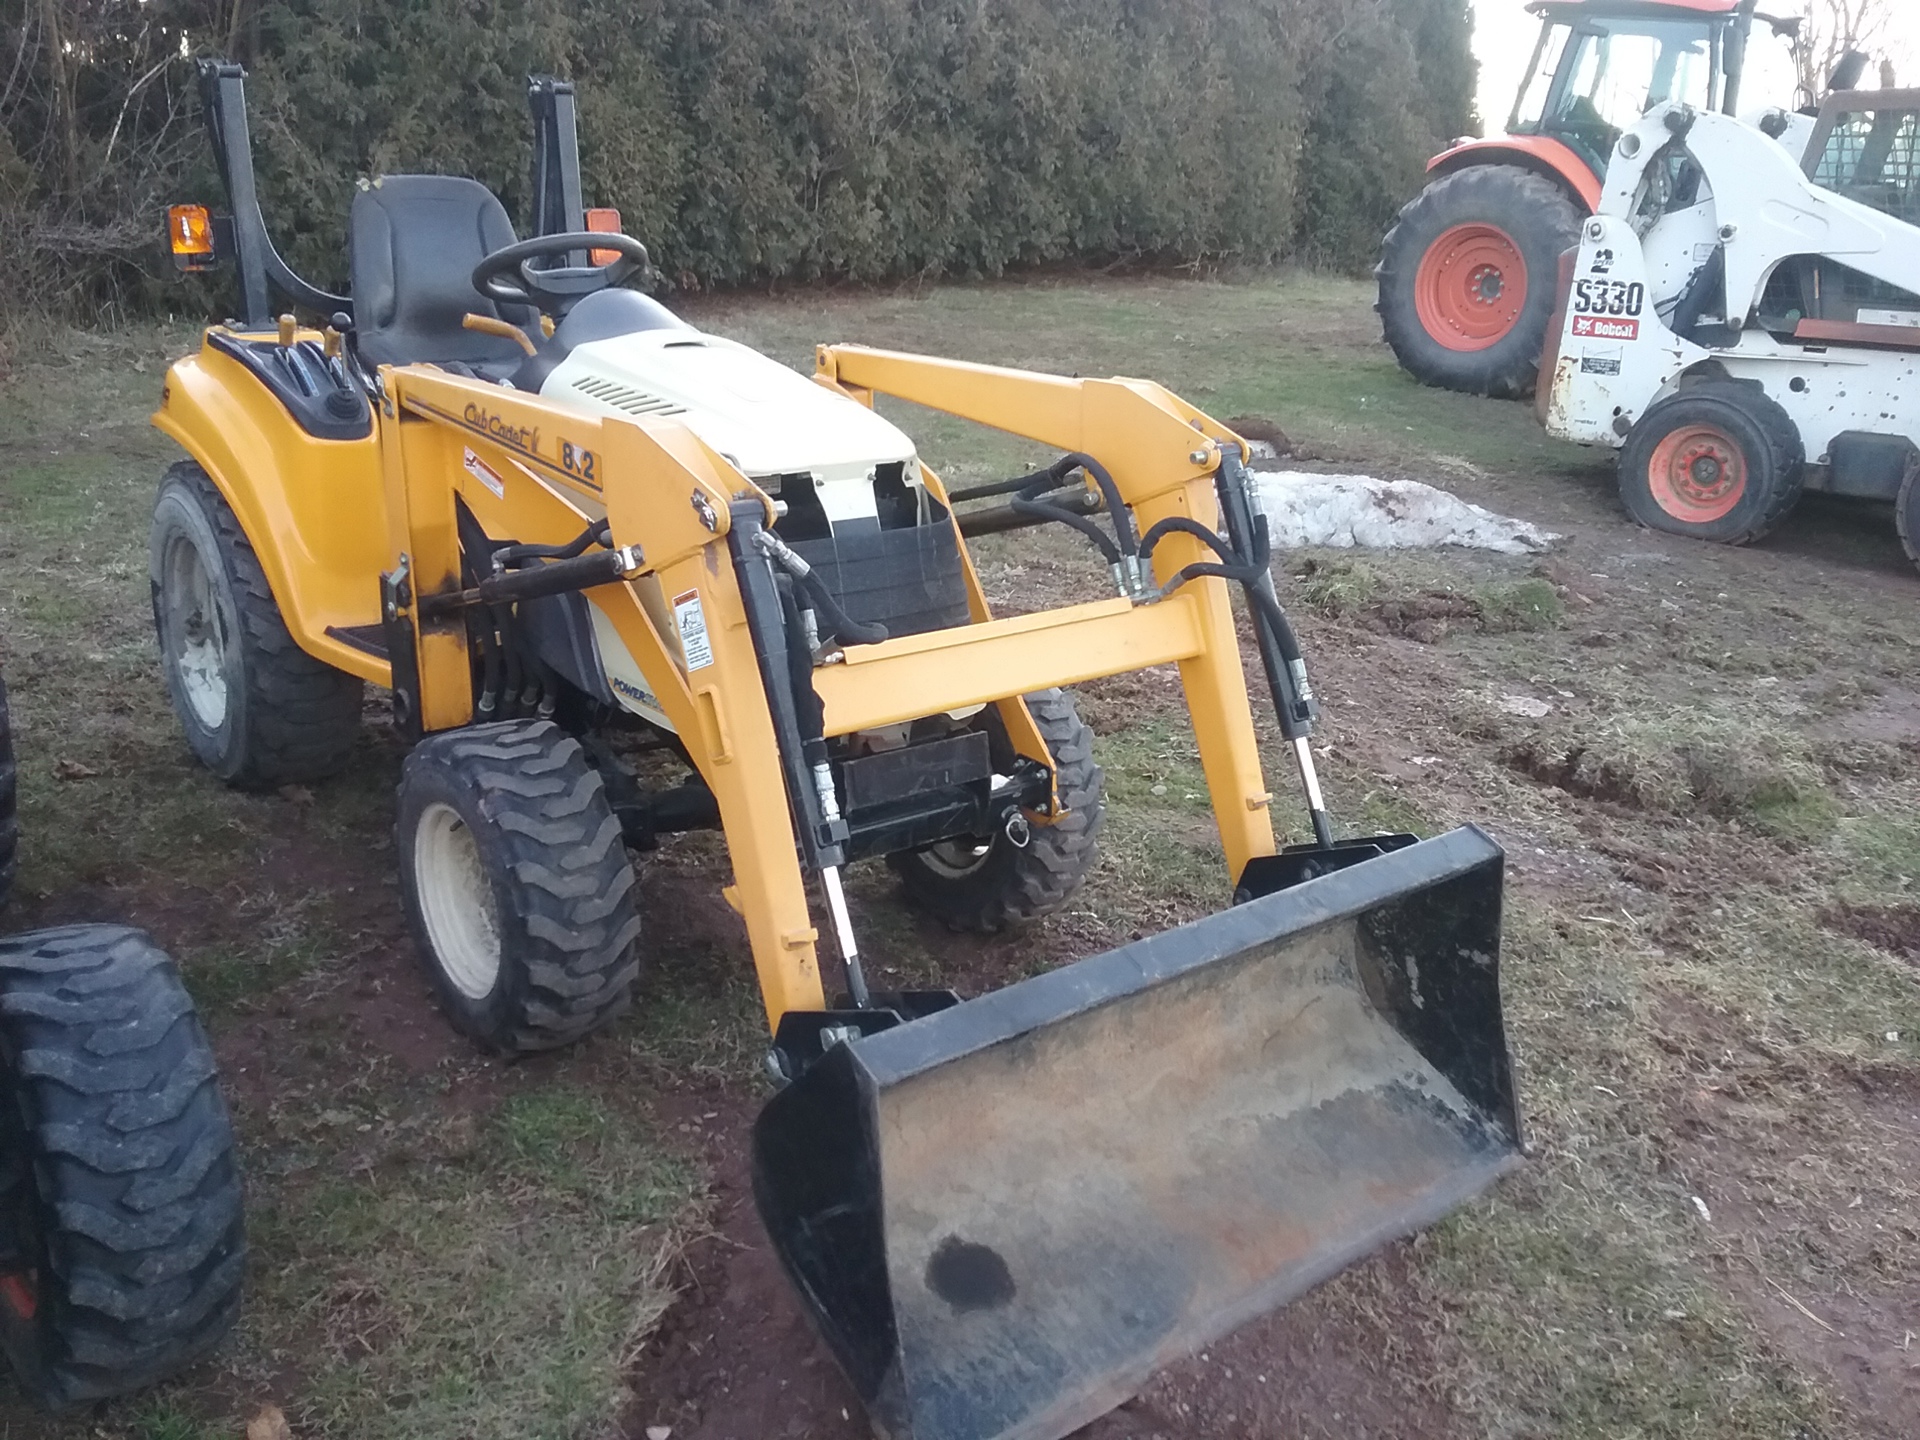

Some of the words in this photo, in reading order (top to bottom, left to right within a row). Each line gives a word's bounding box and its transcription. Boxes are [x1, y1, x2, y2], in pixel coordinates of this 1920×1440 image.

[1591, 249, 1613, 274] 2
[1575, 279, 1644, 316] S330
[1594, 321, 1633, 338] Bobcat
[464, 403, 487, 430] Cub
[489, 415, 530, 449] Cadet
